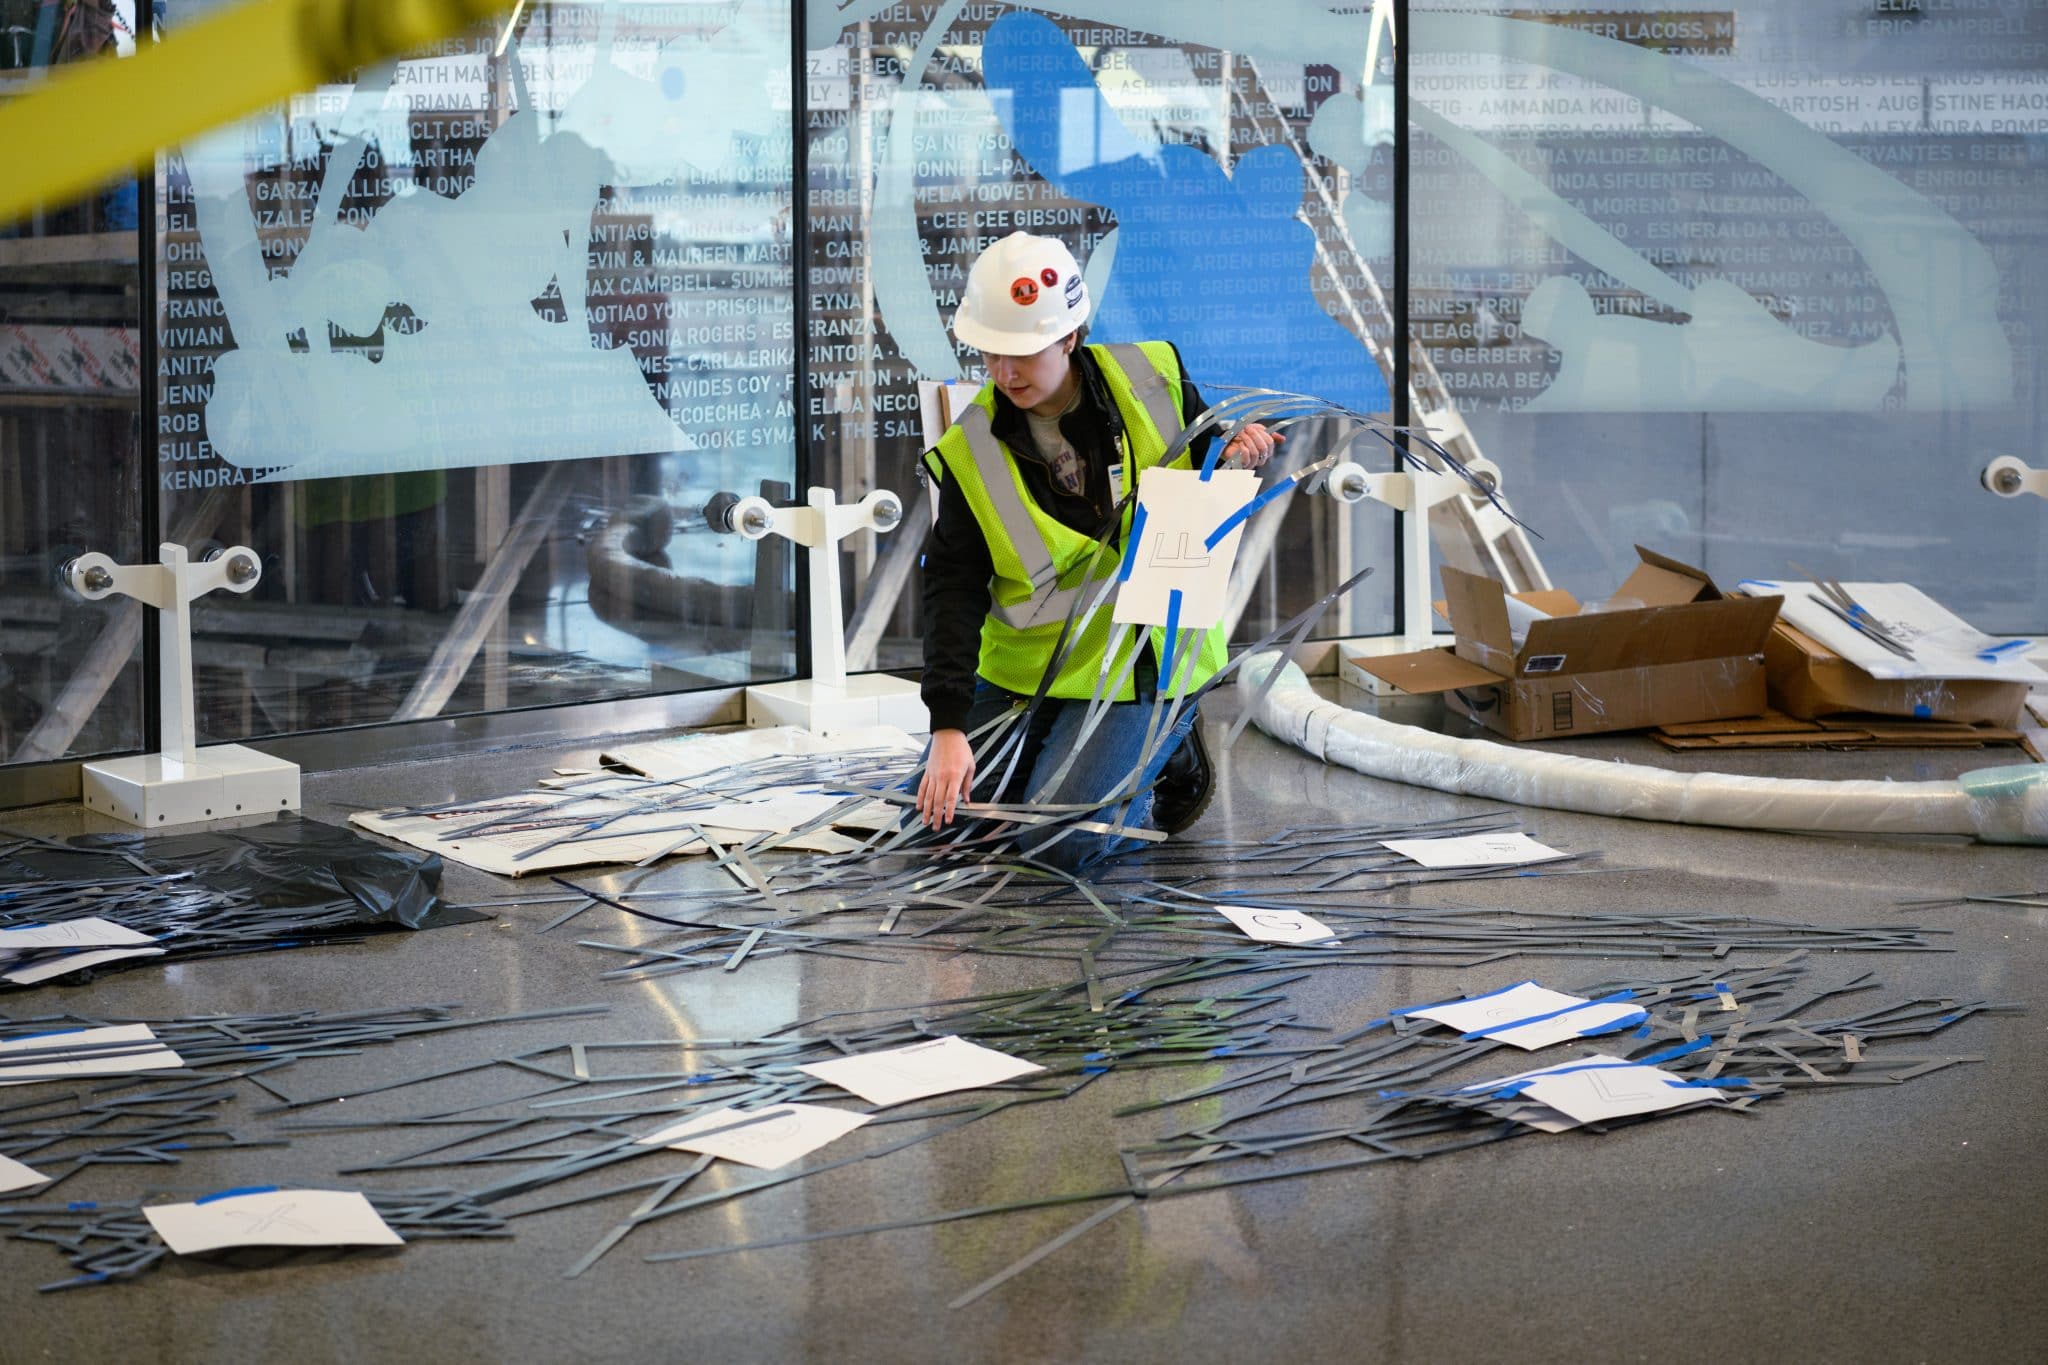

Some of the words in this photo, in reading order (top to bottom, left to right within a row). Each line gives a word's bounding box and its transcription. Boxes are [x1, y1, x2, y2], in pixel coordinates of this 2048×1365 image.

[921, 2, 1005, 23] VQUEZ
[885, 31, 963, 49] CAREN
[1048, 28, 1149, 47] GUTIERREZ
[397, 65, 448, 84] FAITH
[454, 62, 512, 83] MARIE
[522, 61, 592, 81] BENAVI
[838, 57, 911, 75] REBECC
[1414, 74, 1528, 91] RODRIGUEZ
[1479, 98, 1584, 116] AMMANDA
[1591, 97, 1642, 115] KNIG
[1878, 94, 1995, 112] AUGUSTINE
[1575, 148, 1649, 165] VALDEZ
[1655, 147, 1729, 164] GARCIA
[737, 162, 792, 182] O'BRIE
[1551, 173, 1602, 190] INDA
[1603, 173, 1715, 190] SIFUENTES
[1731, 173, 1777, 190] IVAN
[1916, 170, 2007, 187] ENRIQUE
[255, 179, 322, 201] GARZA
[967, 183, 1036, 203] TOOVEY
[336, 206, 382, 225] CON
[1594, 198, 1680, 215] MORENO
[932, 210, 969, 230] CEE
[973, 209, 1009, 228] CEE
[1013, 207, 1082, 227] GIBSON
[1097, 206, 1174, 227] VALERIE
[1648, 222, 1769, 239] ESMERALDA
[587, 250, 627, 271] EVIN
[632, 250, 645, 268] &
[652, 246, 743, 268] MAUREEN
[743, 242, 792, 262] MART
[1699, 246, 1771, 264] WYCHE
[158, 270, 215, 291] GREG
[620, 272, 716, 296] CAMPBELL
[731, 270, 793, 290] SUMME
[810, 265, 873, 286] BOWE
[1836, 270, 1877, 287] MAR
[652, 302, 689, 321] YUN
[705, 297, 793, 320] PRISCILLA
[809, 292, 865, 312] EYNA
[157, 326, 224, 348] VIVIAN
[627, 327, 681, 349] SONIA
[687, 323, 756, 345] ROGERS
[1421, 322, 1499, 339] LEAGUE
[157, 354, 216, 376] ANITA
[686, 351, 747, 373] CARLA
[1450, 347, 1532, 365] GERBER
[737, 374, 770, 394] COY
[1414, 371, 1510, 391] BARBARA
[158, 384, 214, 407] JENN
[870, 392, 920, 412] NECO
[884, 418, 922, 438] SAL
[160, 467, 246, 491] KENDRA
